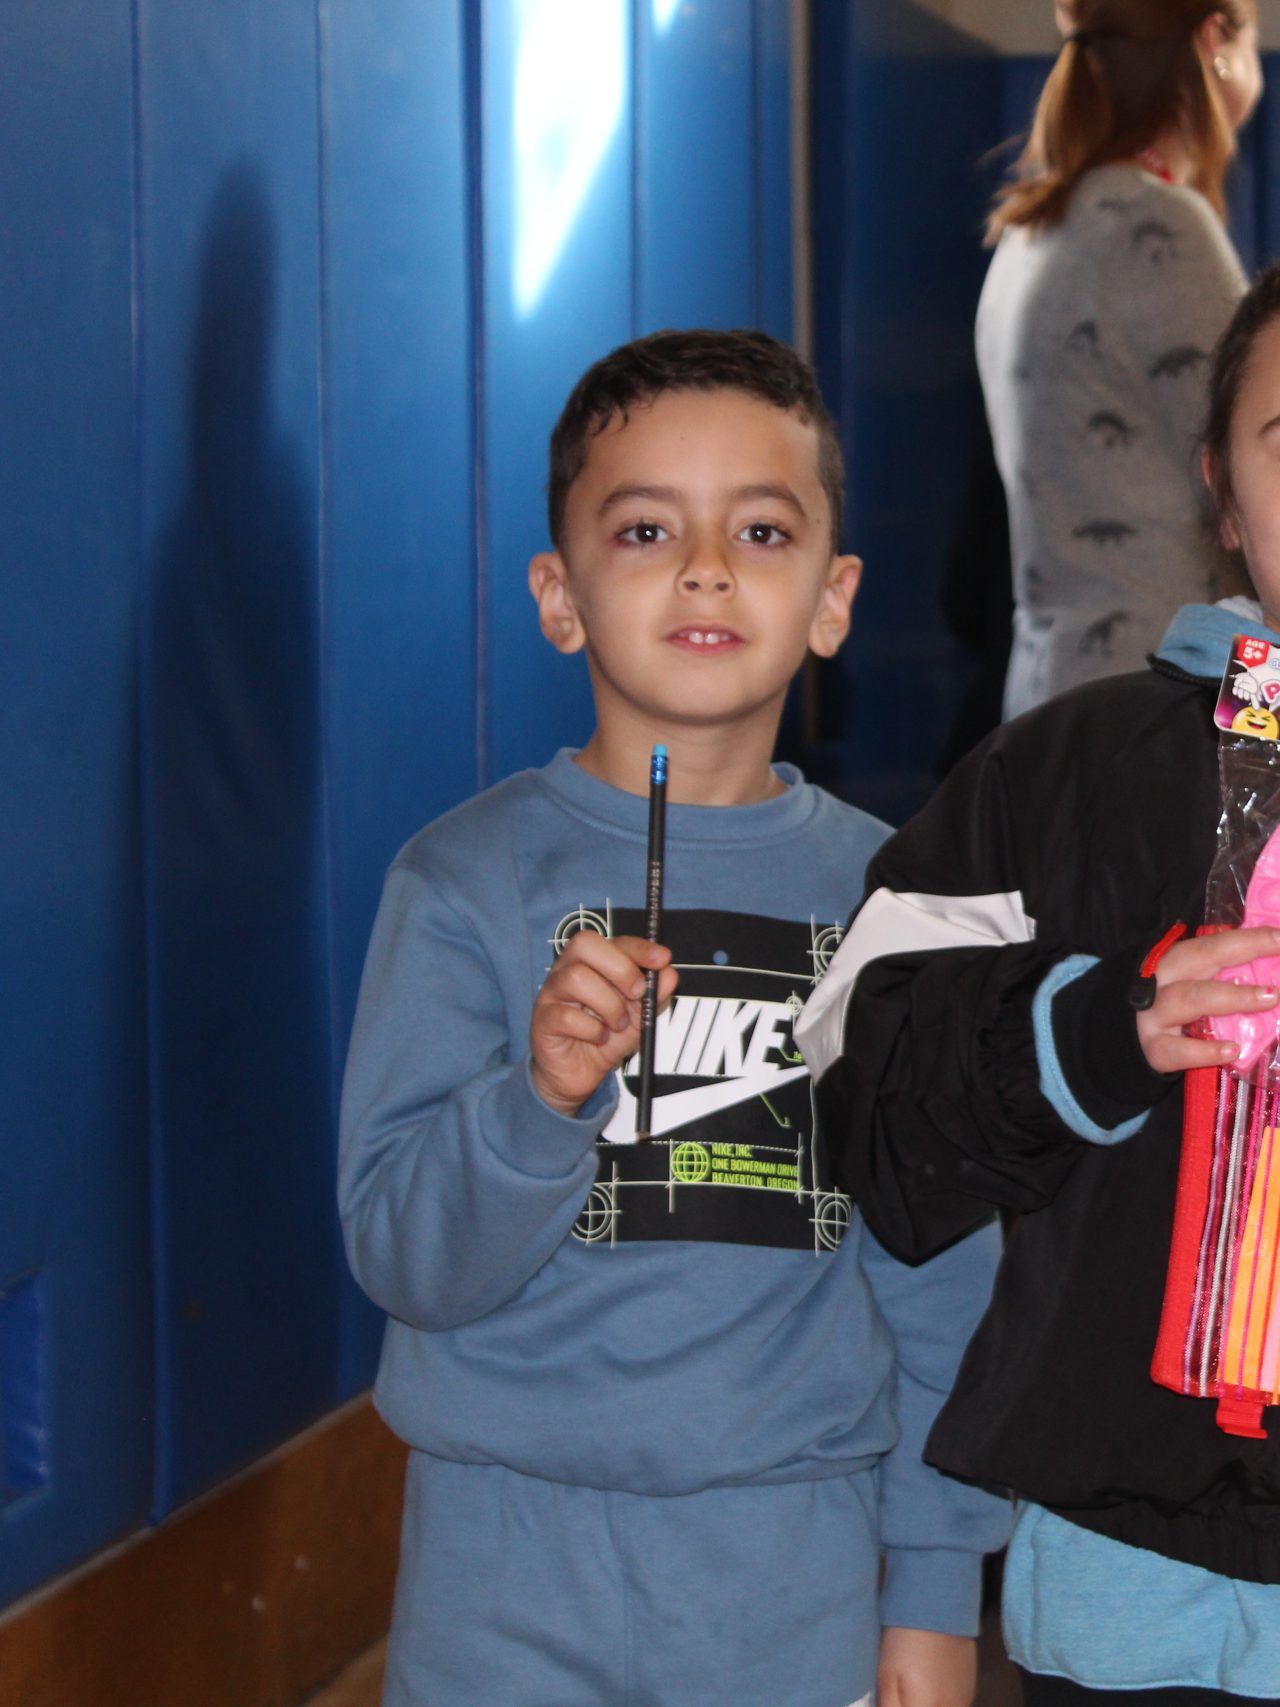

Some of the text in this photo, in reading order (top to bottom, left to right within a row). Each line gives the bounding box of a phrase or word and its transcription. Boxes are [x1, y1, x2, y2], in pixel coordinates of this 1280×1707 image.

[1245, 639, 1266, 649] AGE
[1243, 647, 1263, 659] 5+
[626, 997, 792, 1076] NIKE
[712, 1158, 799, 1177] ONE BOWERMAN DRIVE
